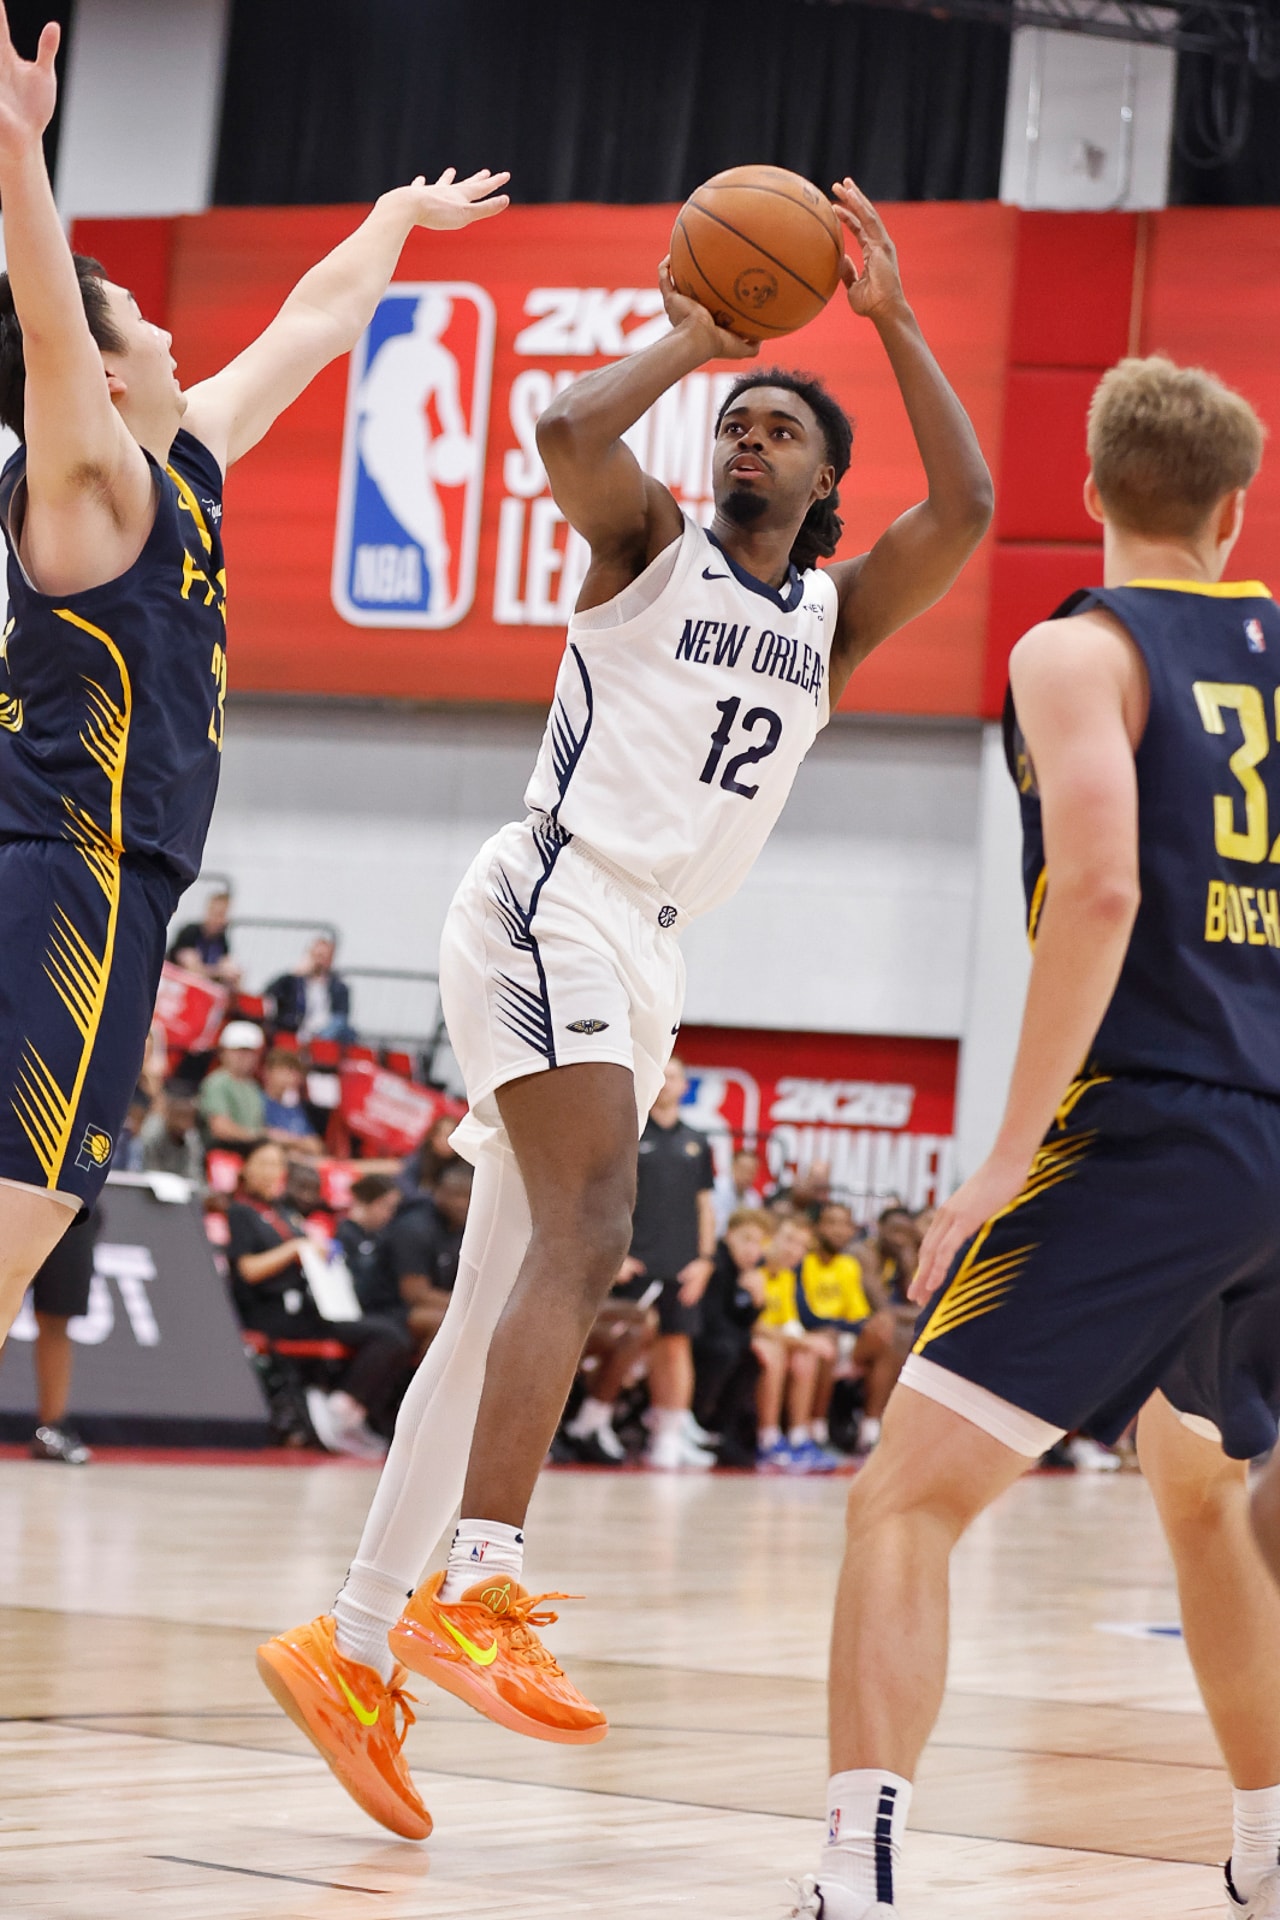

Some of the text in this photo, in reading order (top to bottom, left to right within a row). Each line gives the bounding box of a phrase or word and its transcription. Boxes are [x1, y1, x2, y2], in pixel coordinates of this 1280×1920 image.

[514, 287, 674, 356] 2K2
[352, 543, 422, 602] NBA
[675, 619, 825, 707] NEW ORLEA
[699, 695, 783, 801] 12
[1192, 681, 1280, 864] 3
[1204, 879, 1280, 949] BOEH
